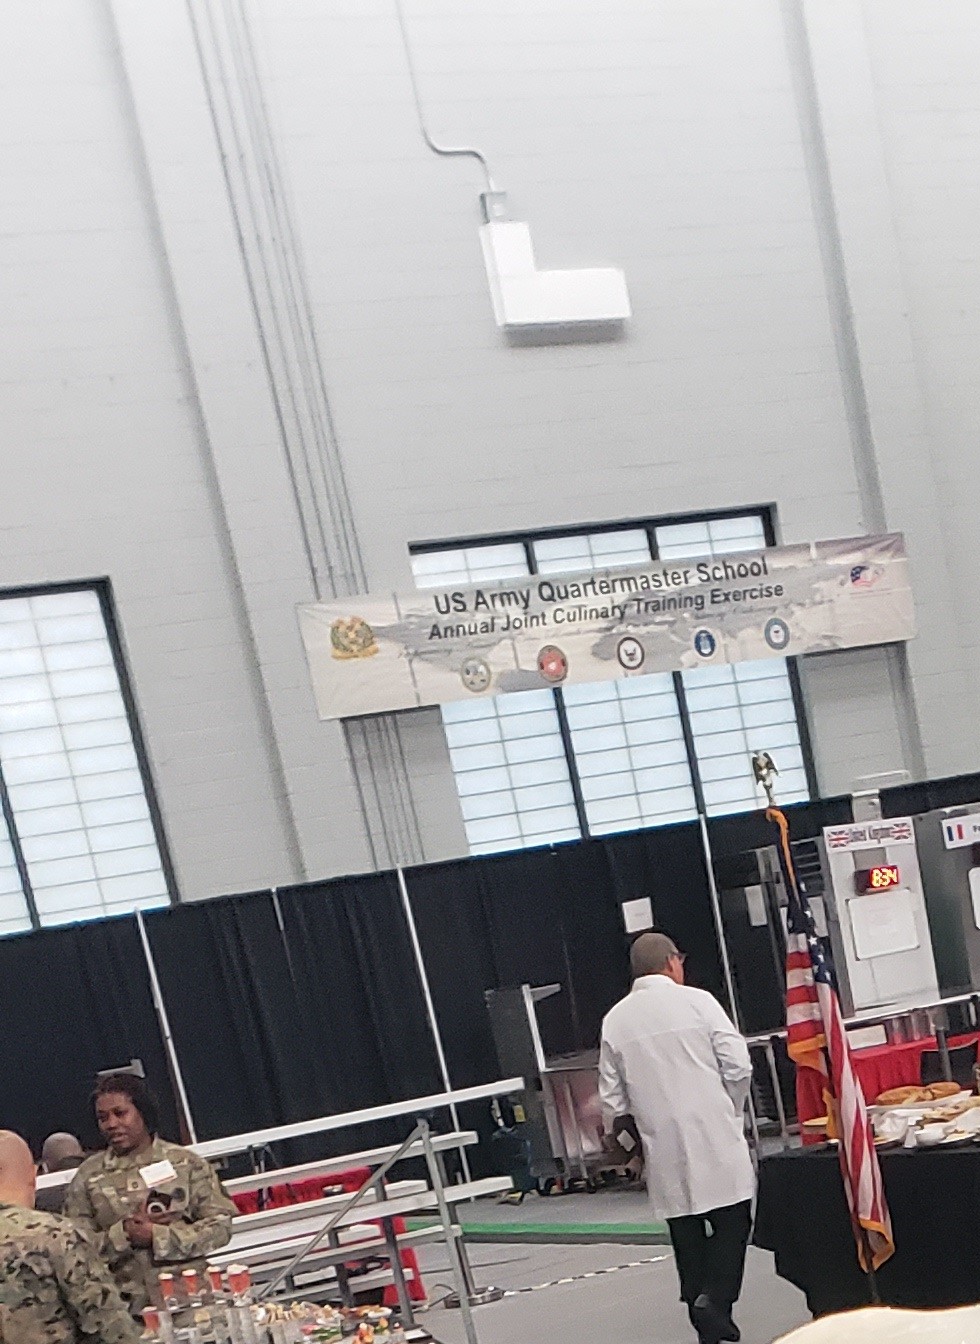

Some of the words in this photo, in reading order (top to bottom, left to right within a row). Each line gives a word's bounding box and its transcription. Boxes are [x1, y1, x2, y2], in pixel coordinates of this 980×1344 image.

[428, 616, 496, 640] Annual
[500, 611, 548, 632] Joint
[552, 601, 628, 625] Culinary
[632, 592, 706, 615] Training
[710, 582, 785, 605] Exercise
[433, 591, 468, 615] US
[473, 588, 531, 611] Army
[537, 568, 691, 602] Quartermaster
[696, 555, 769, 583] School
